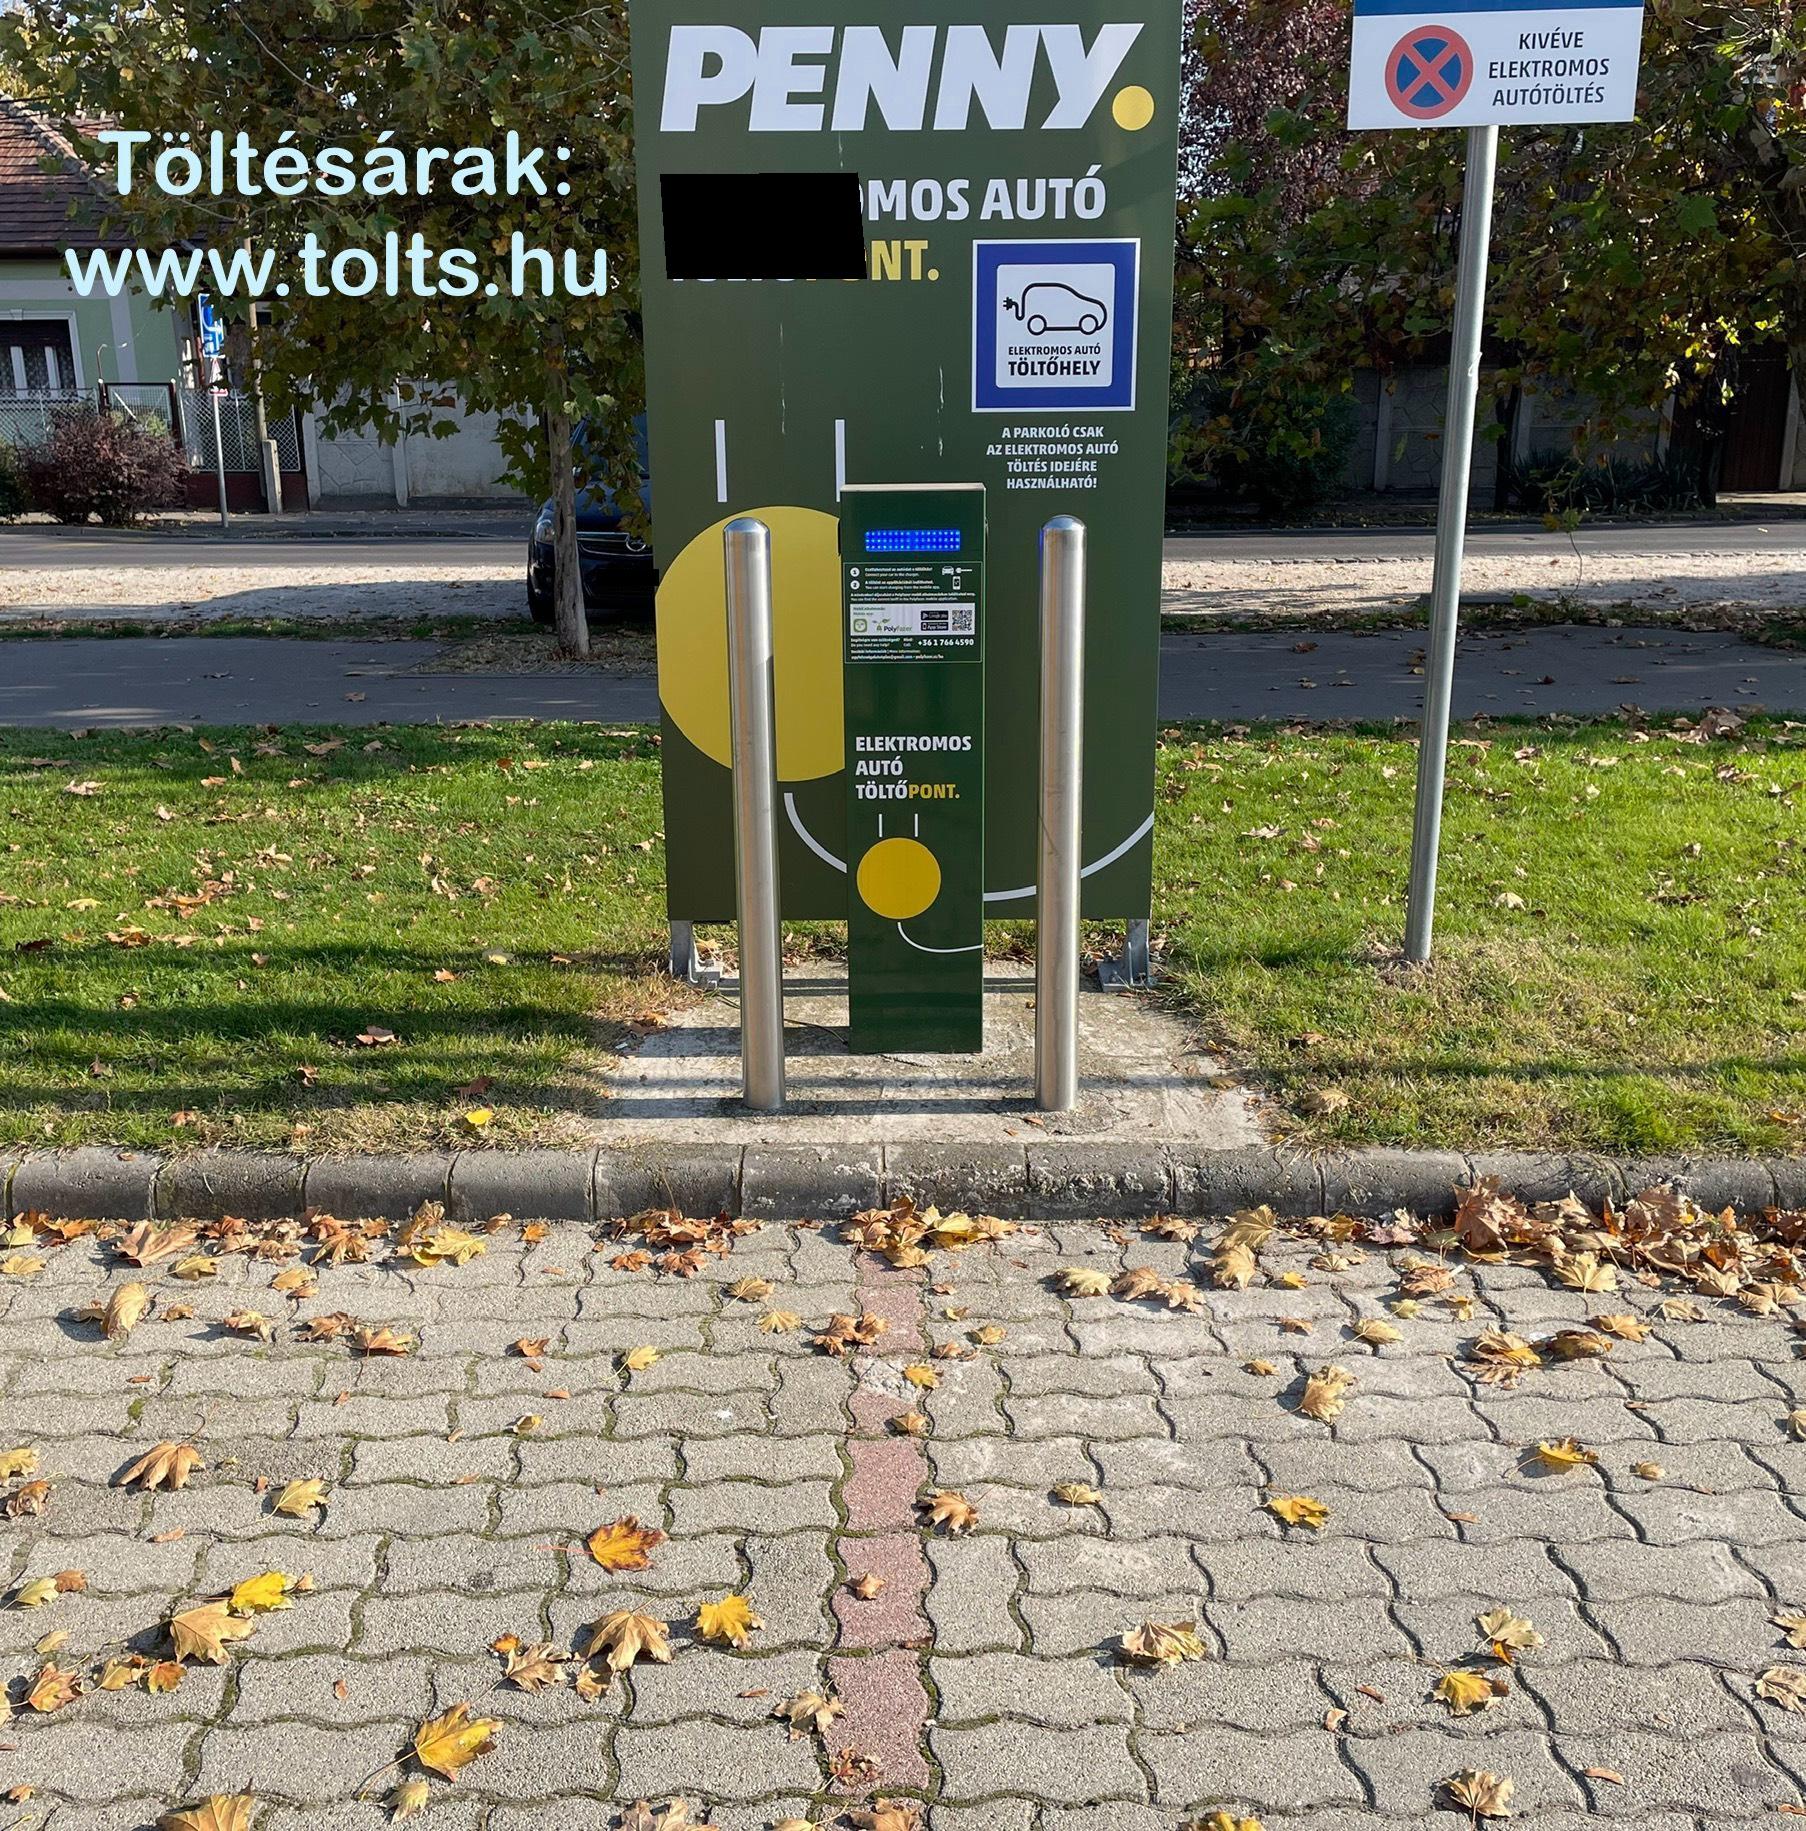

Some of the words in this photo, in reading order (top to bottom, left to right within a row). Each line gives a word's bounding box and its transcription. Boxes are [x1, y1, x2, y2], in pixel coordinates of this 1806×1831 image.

[1519, 27, 1584, 50] KIVÉVE
[1488, 58, 1610, 79] ELEKTROMOS
[1492, 82, 1605, 106] AUTÓTÖLTÉS
[979, 165, 1106, 220] AUTÓ
[1008, 346, 1072, 355] ELEKTROMOS
[1074, 343, 1101, 355] AUTÓ
[1008, 356, 1101, 376] TÖLTŐHELY
[1002, 427, 1011, 438] A
[1014, 424, 1069, 438] PARKOLÓ
[1073, 427, 1104, 438] CSAK
[986, 444, 1002, 456] AZ
[1005, 443, 1083, 455] ELEKTROMOS
[1085, 440, 1119, 455] AUTÓ
[1007, 458, 1047, 472] TÖLTÉS
[1050, 458, 1097, 472] IDEJÉRE
[1006, 474, 1098, 489] HASZNÁLHATÓ!
[856, 736, 971, 751] ELEKTROMOS
[855, 755, 903, 776] AUTÓ
[855, 780, 960, 799] TÖLTŐPONT.
